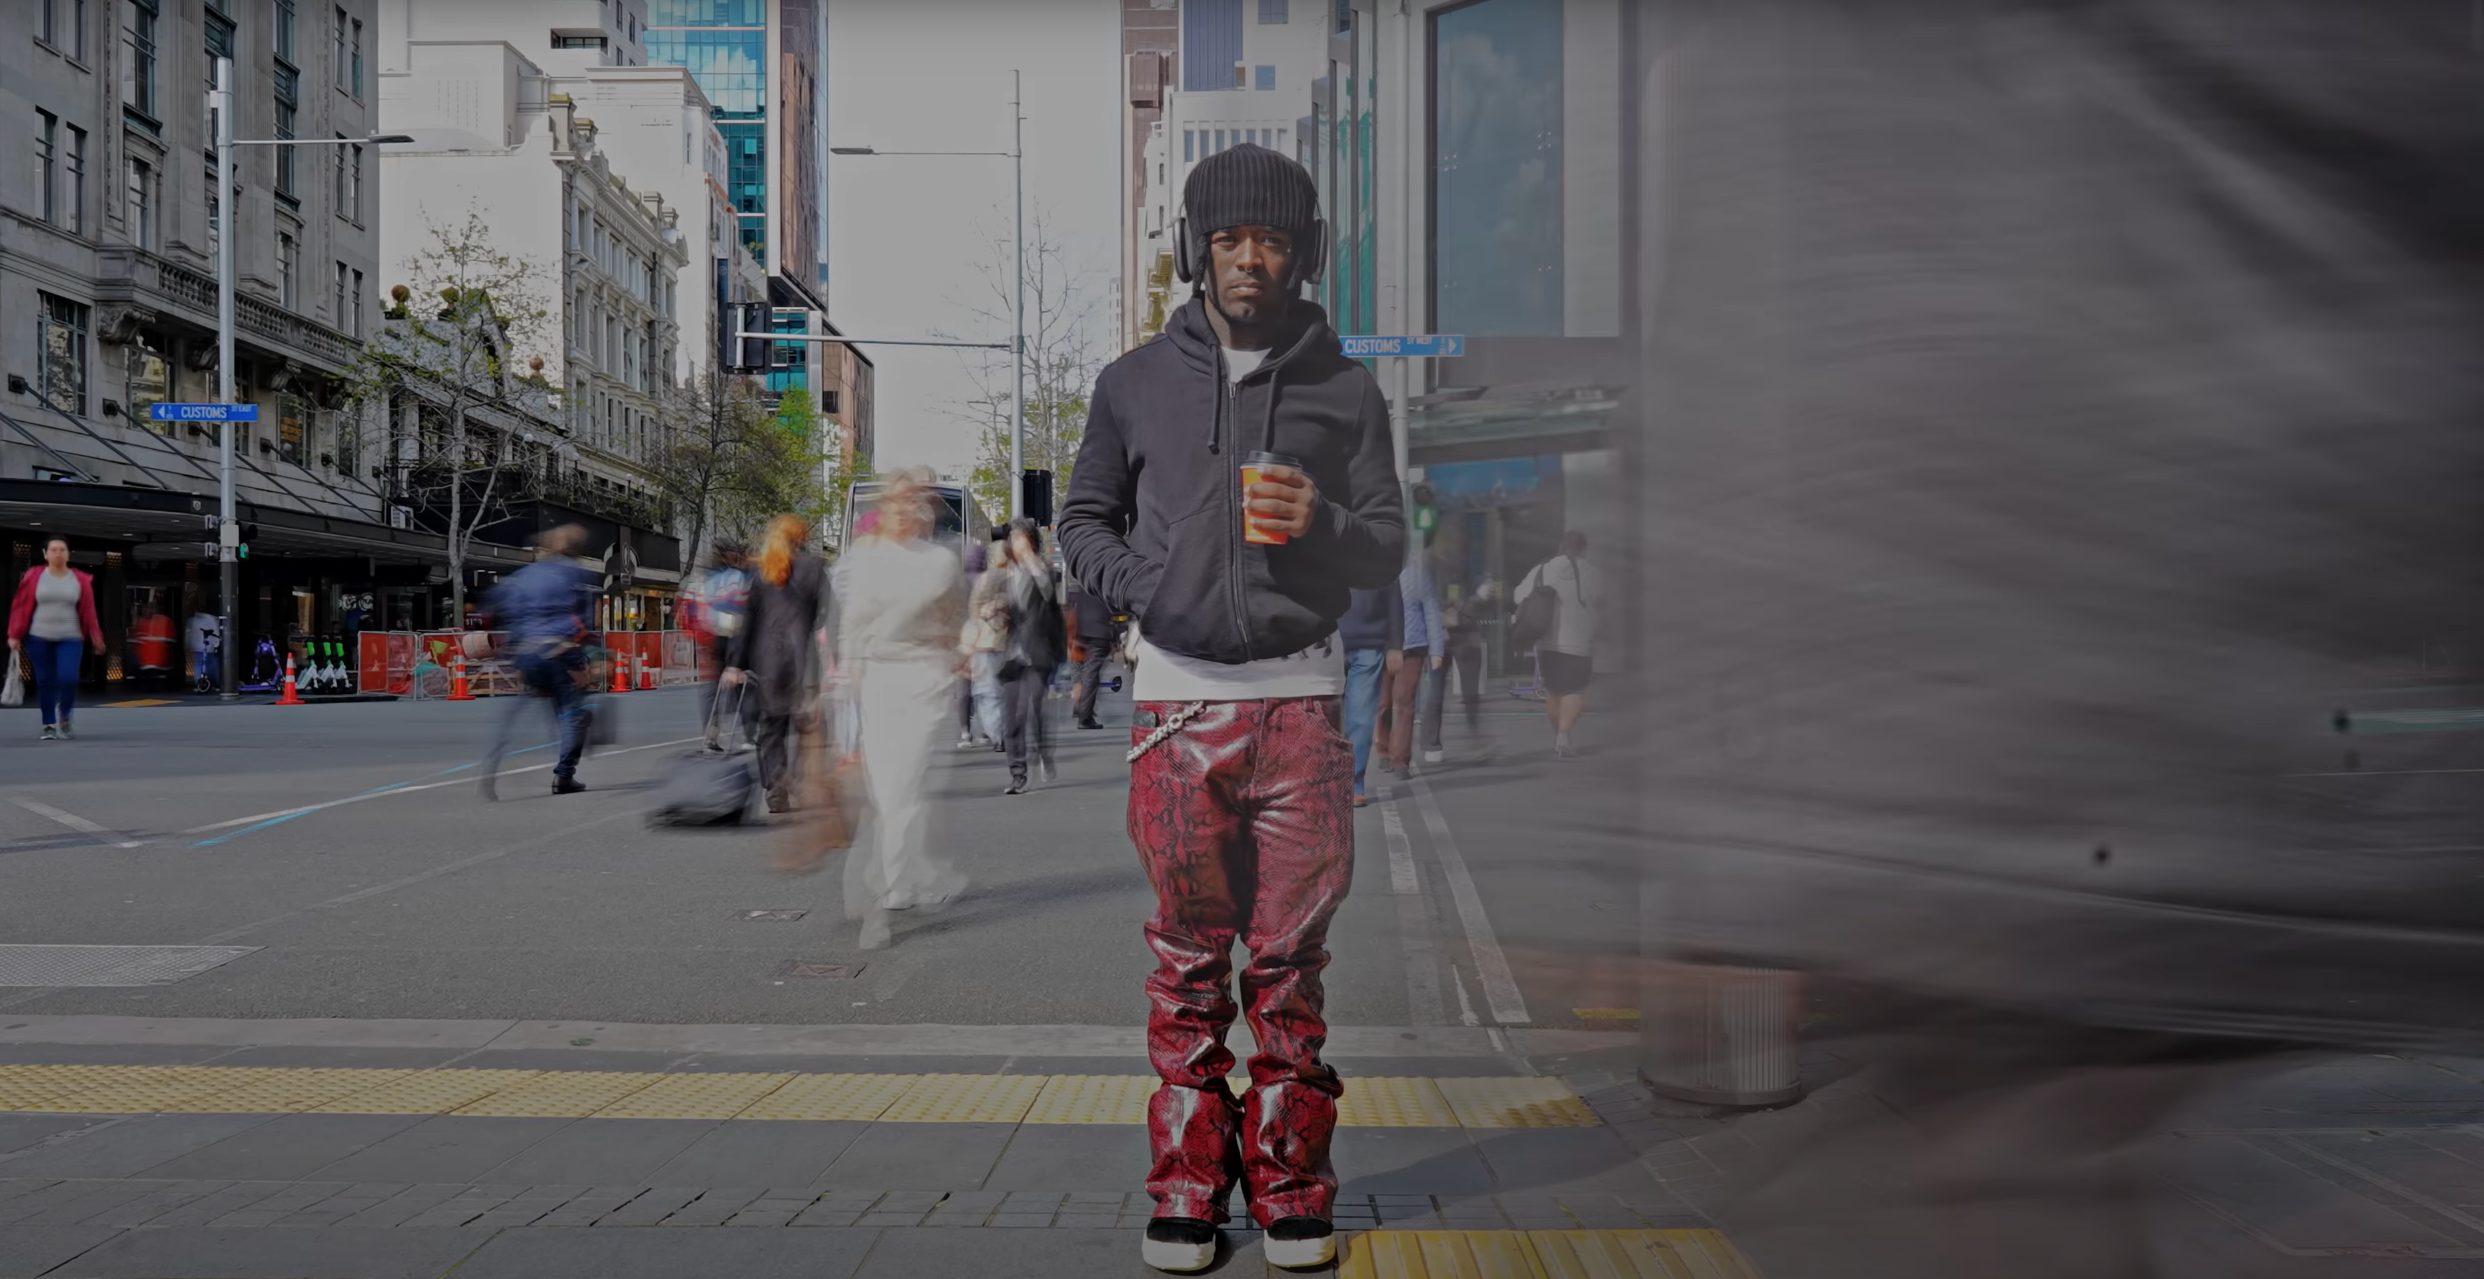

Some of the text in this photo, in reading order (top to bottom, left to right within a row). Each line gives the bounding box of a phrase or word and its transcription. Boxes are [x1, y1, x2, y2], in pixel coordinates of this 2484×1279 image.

[1343, 338, 1401, 353] CUSTOMS
[1415, 336, 1432, 345] WEST
[180, 406, 228, 418] CUSTOMS
